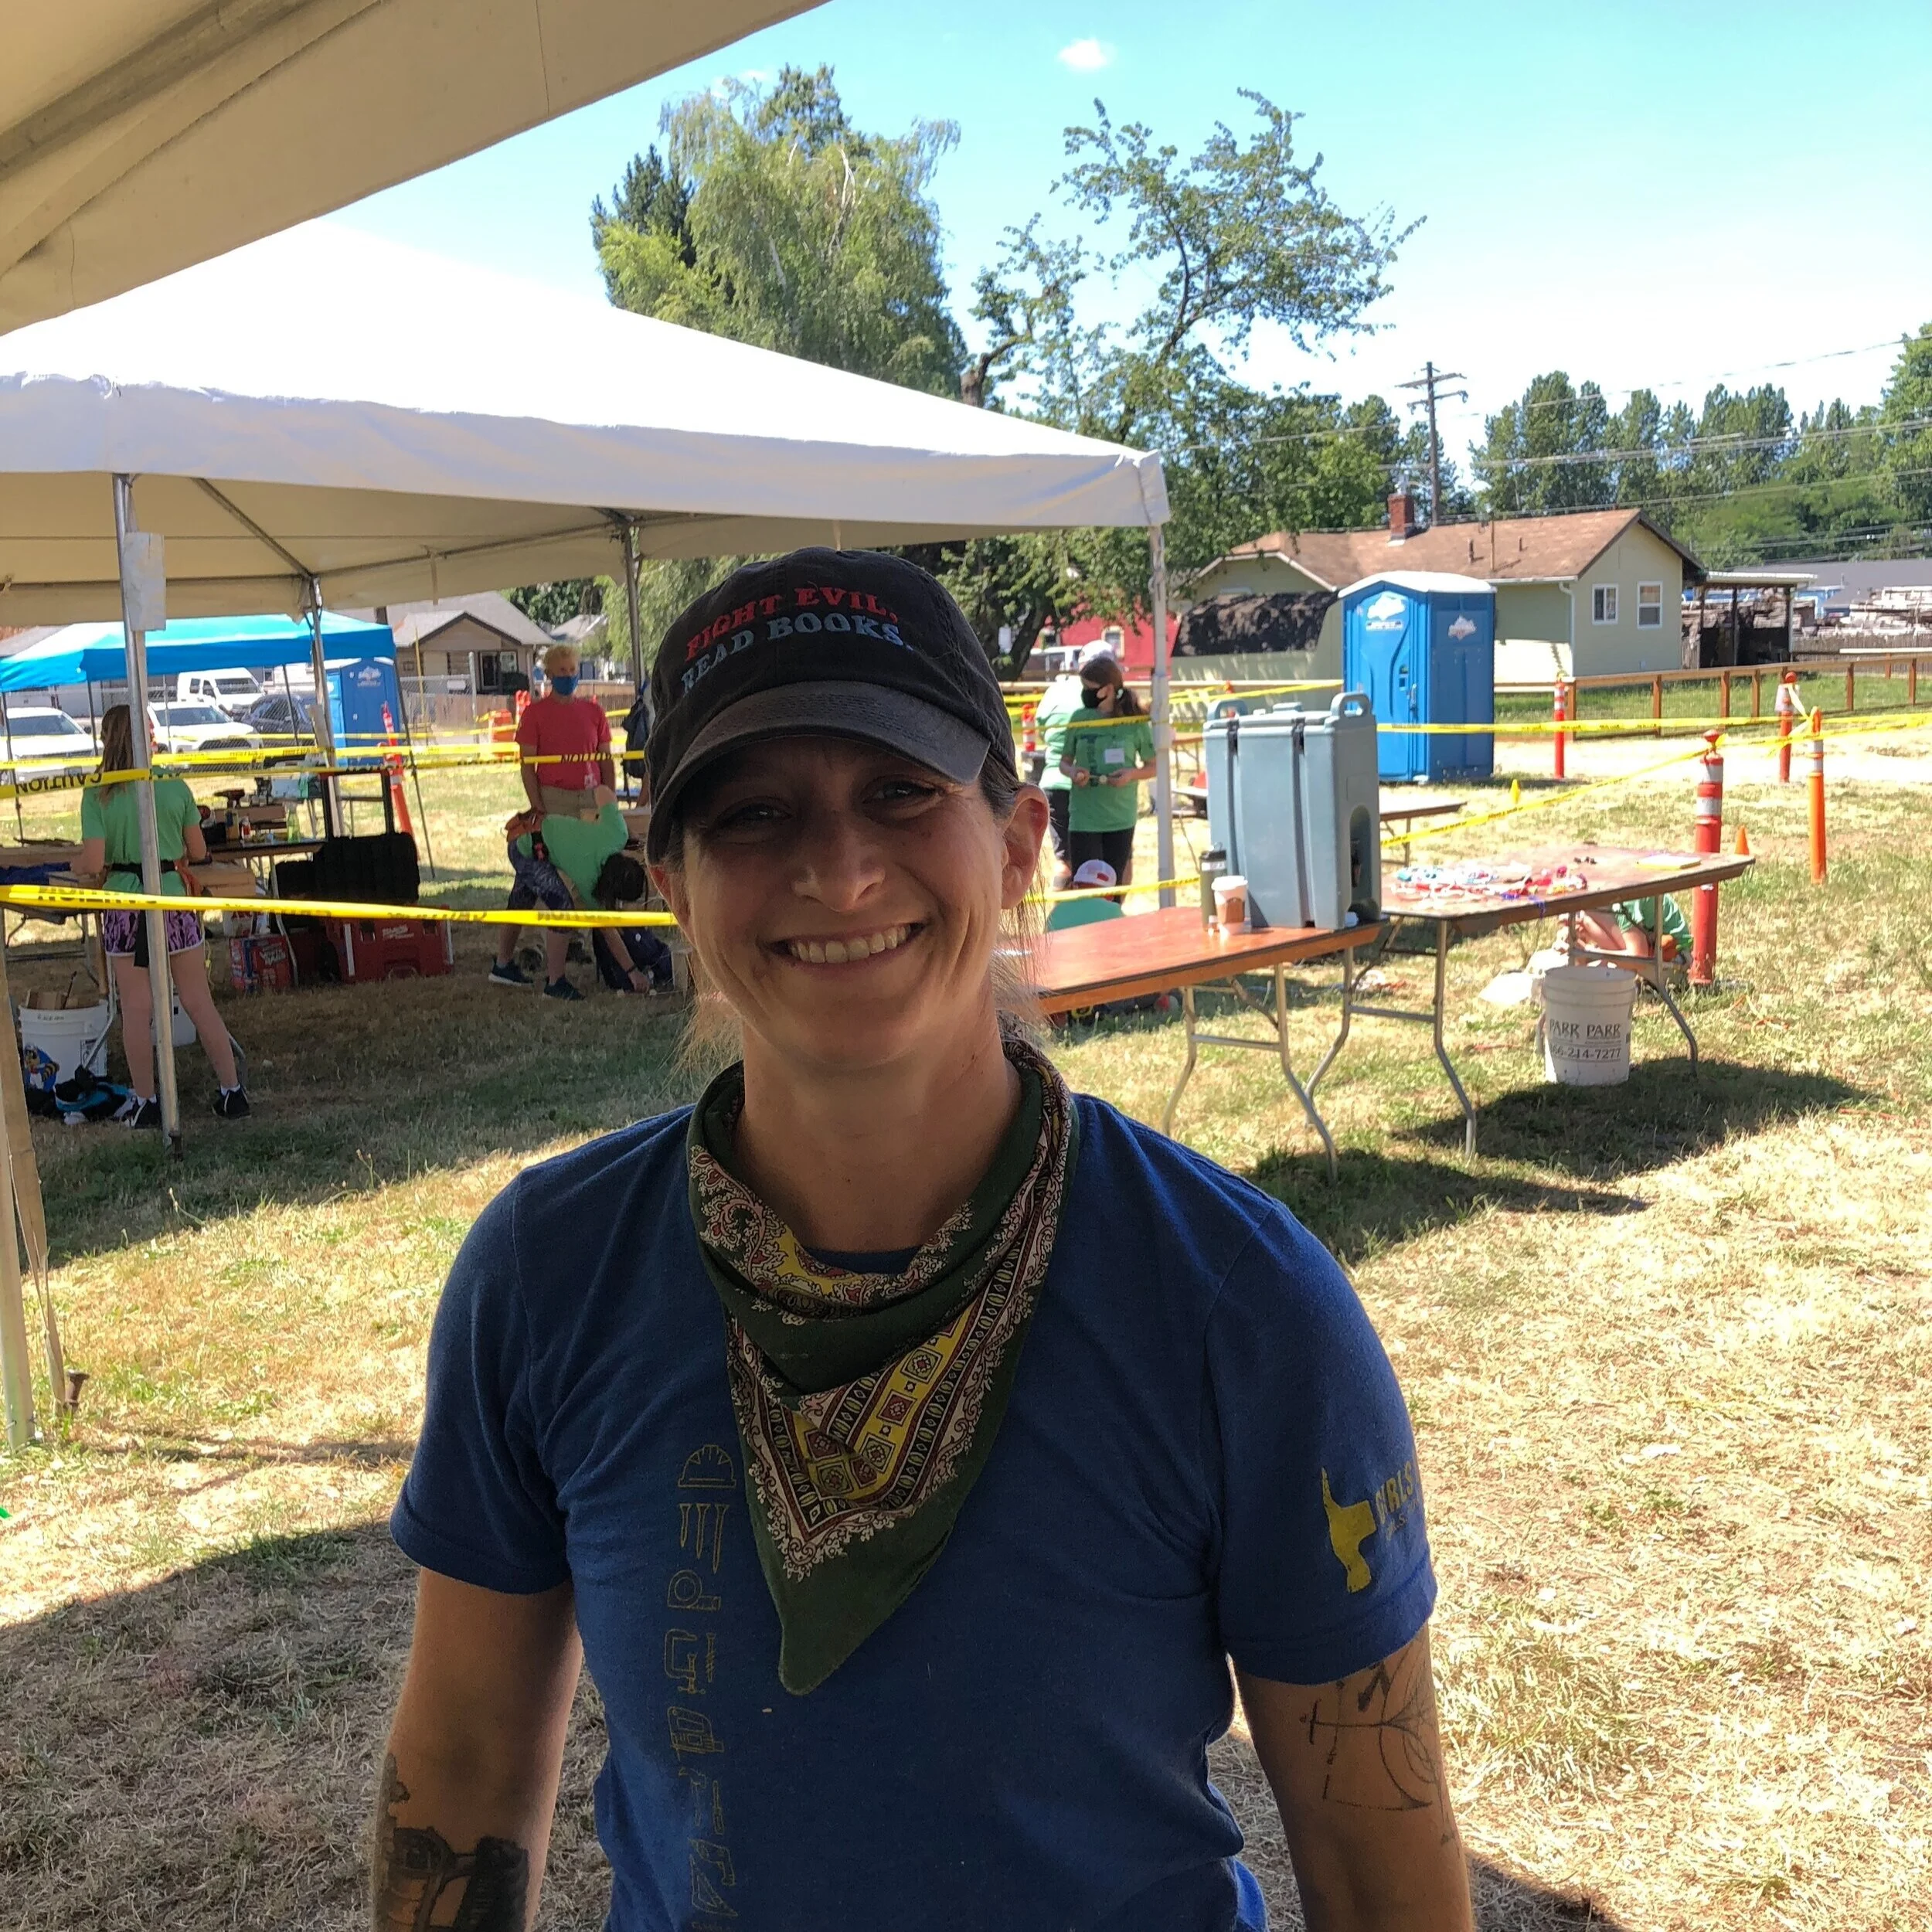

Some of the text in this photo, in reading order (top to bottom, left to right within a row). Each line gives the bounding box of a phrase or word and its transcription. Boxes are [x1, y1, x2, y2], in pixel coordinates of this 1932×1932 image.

[685, 587, 899, 662] FIGHT EVIL,
[680, 612, 913, 694] READ BOOKS.
[15, 773, 102, 794] CAUTION
[1549, 1019, 1621, 1039] PARR PARR
